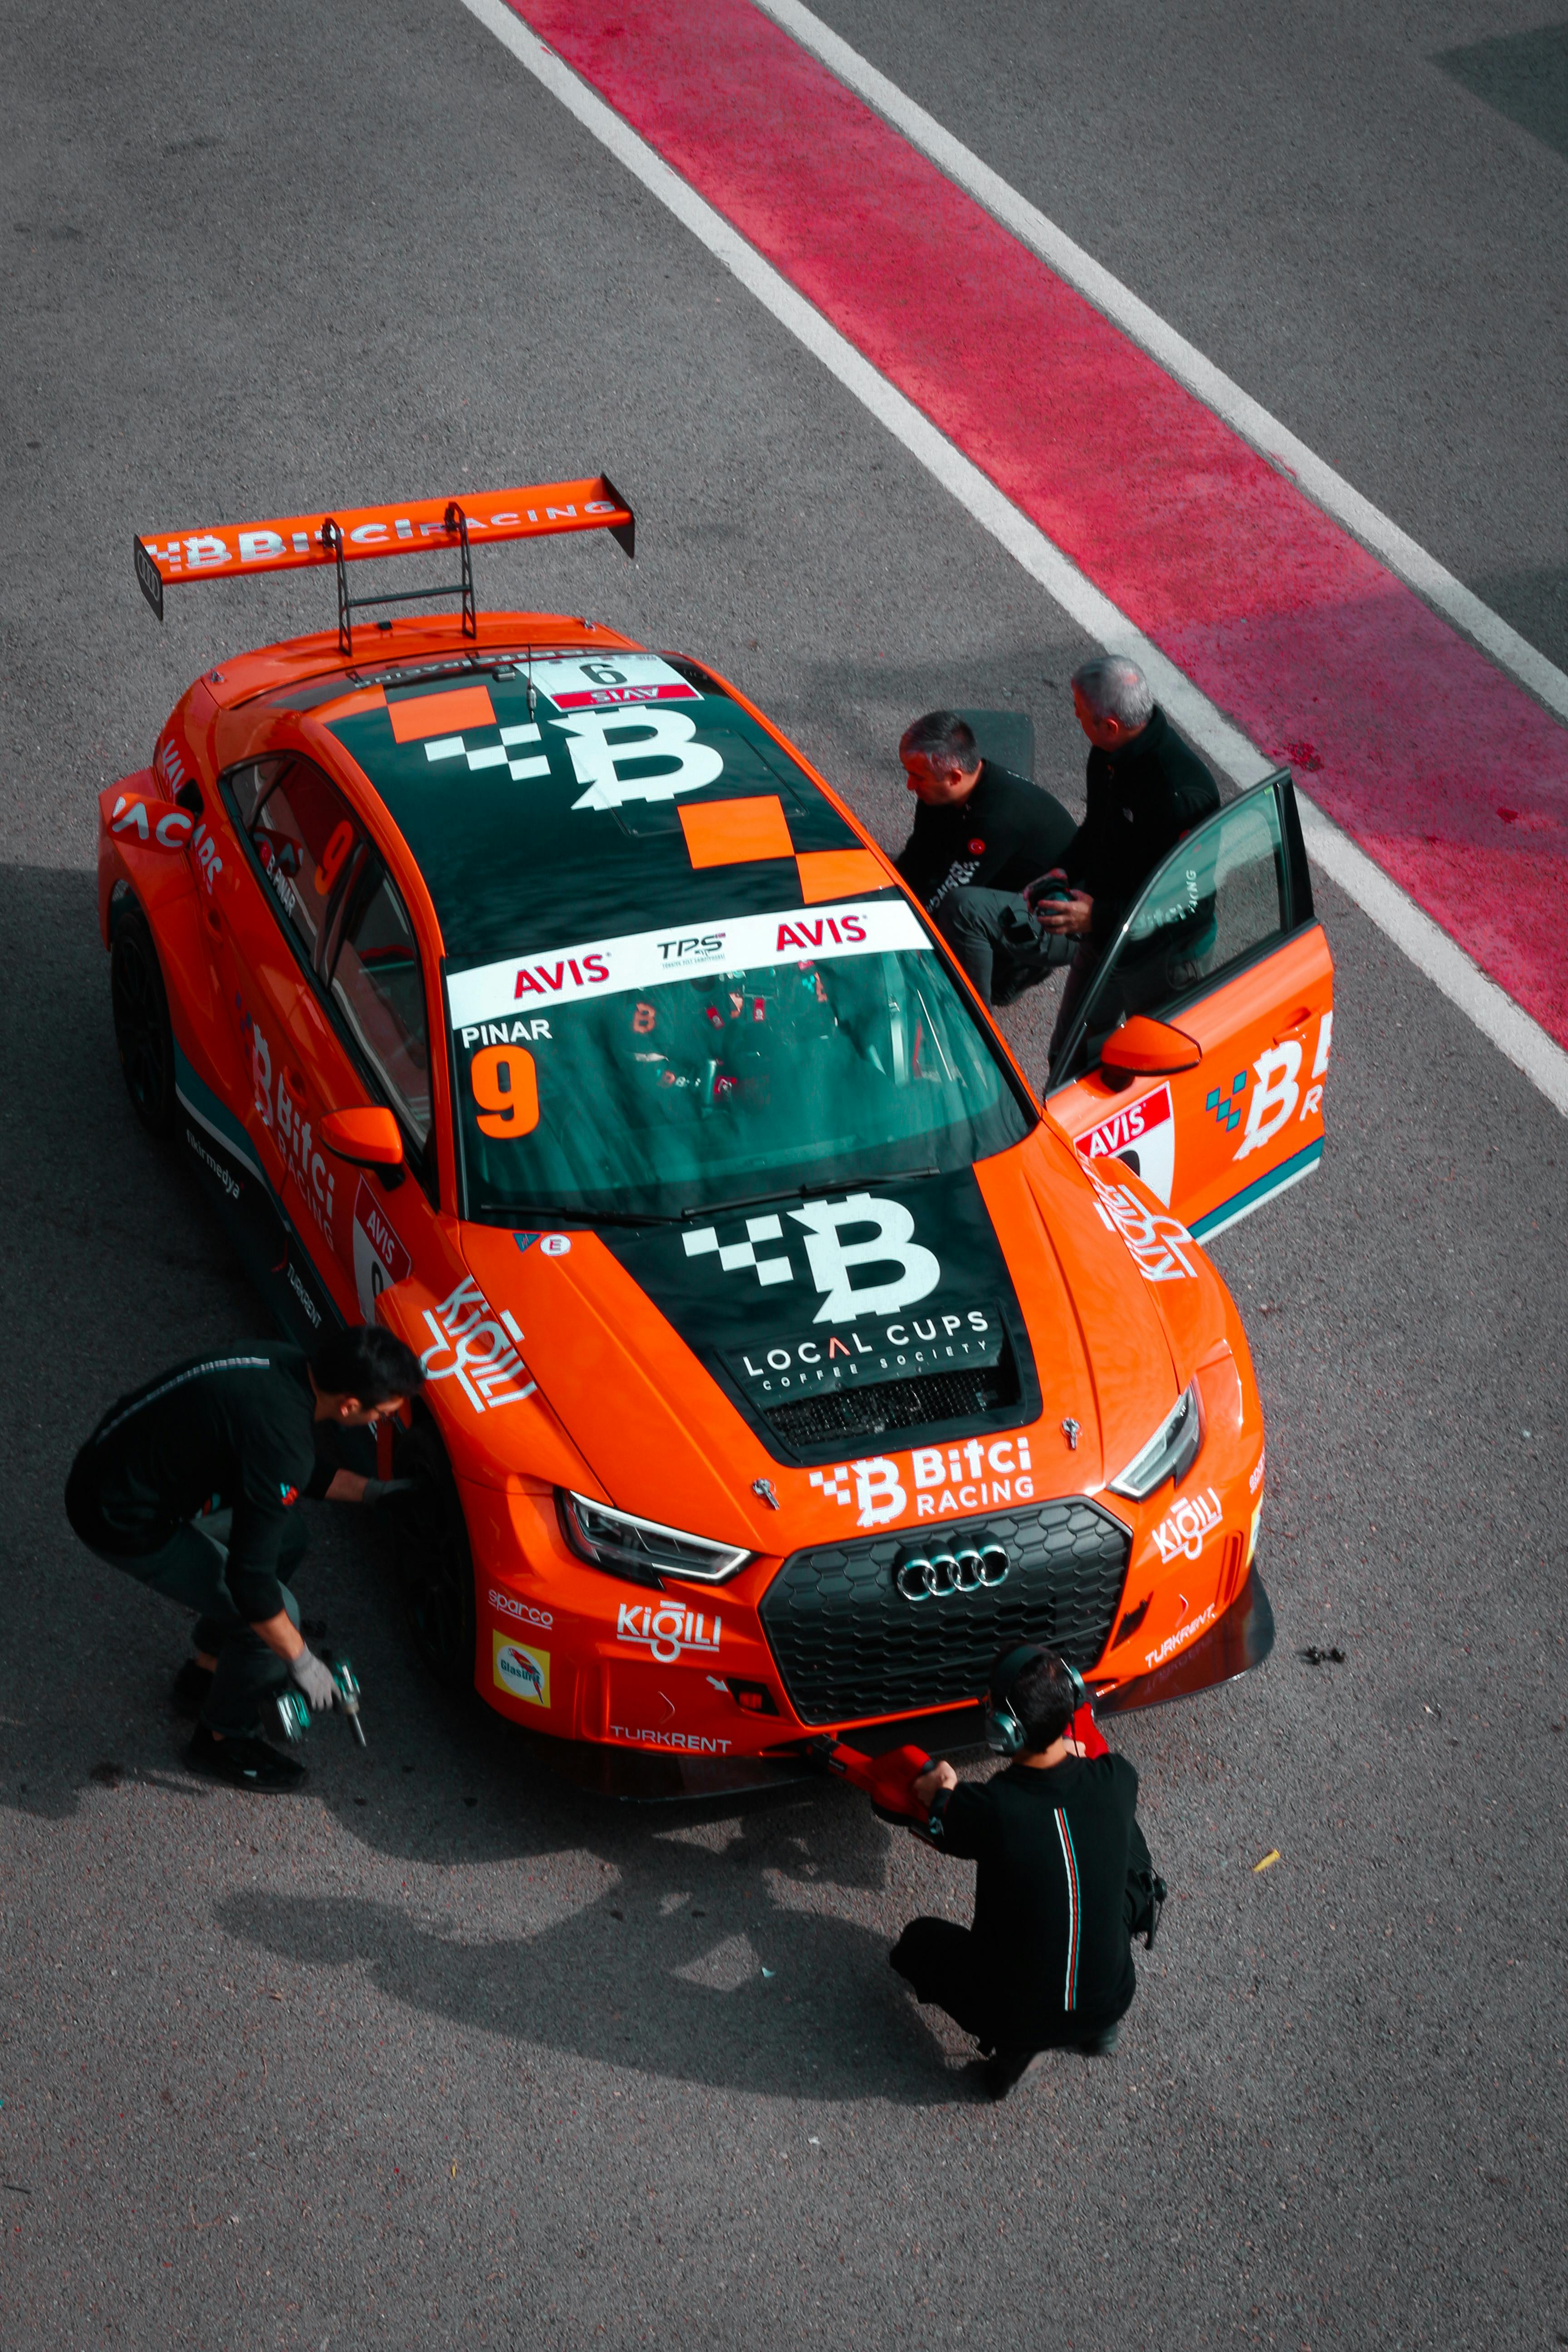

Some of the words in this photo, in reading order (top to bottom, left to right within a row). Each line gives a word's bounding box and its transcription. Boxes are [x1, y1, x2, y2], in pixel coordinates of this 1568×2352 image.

[591, 685, 660, 705] AVIS
[657, 935, 722, 960] TPS
[776, 915, 867, 952] AVIS
[514, 953, 609, 1000] AVIS
[461, 1019, 553, 1049] PINAR
[471, 1044, 539, 1140] 9
[1090, 1104, 1145, 1157] AVIS
[278, 1134, 334, 1252] RACING
[367, 1210, 395, 1265] AVIS
[743, 1333, 873, 1377] LOCAL
[886, 1310, 988, 1346] CUPS
[763, 1363, 858, 1391] COFFEE
[879, 1340, 987, 1369] SOCIETY
[916, 1475, 1034, 1517] RACING
[488, 1589, 554, 1628] sparco
[1145, 1602, 1216, 1668] TURKRENT
[609, 1725, 732, 1754] TURKRENT
